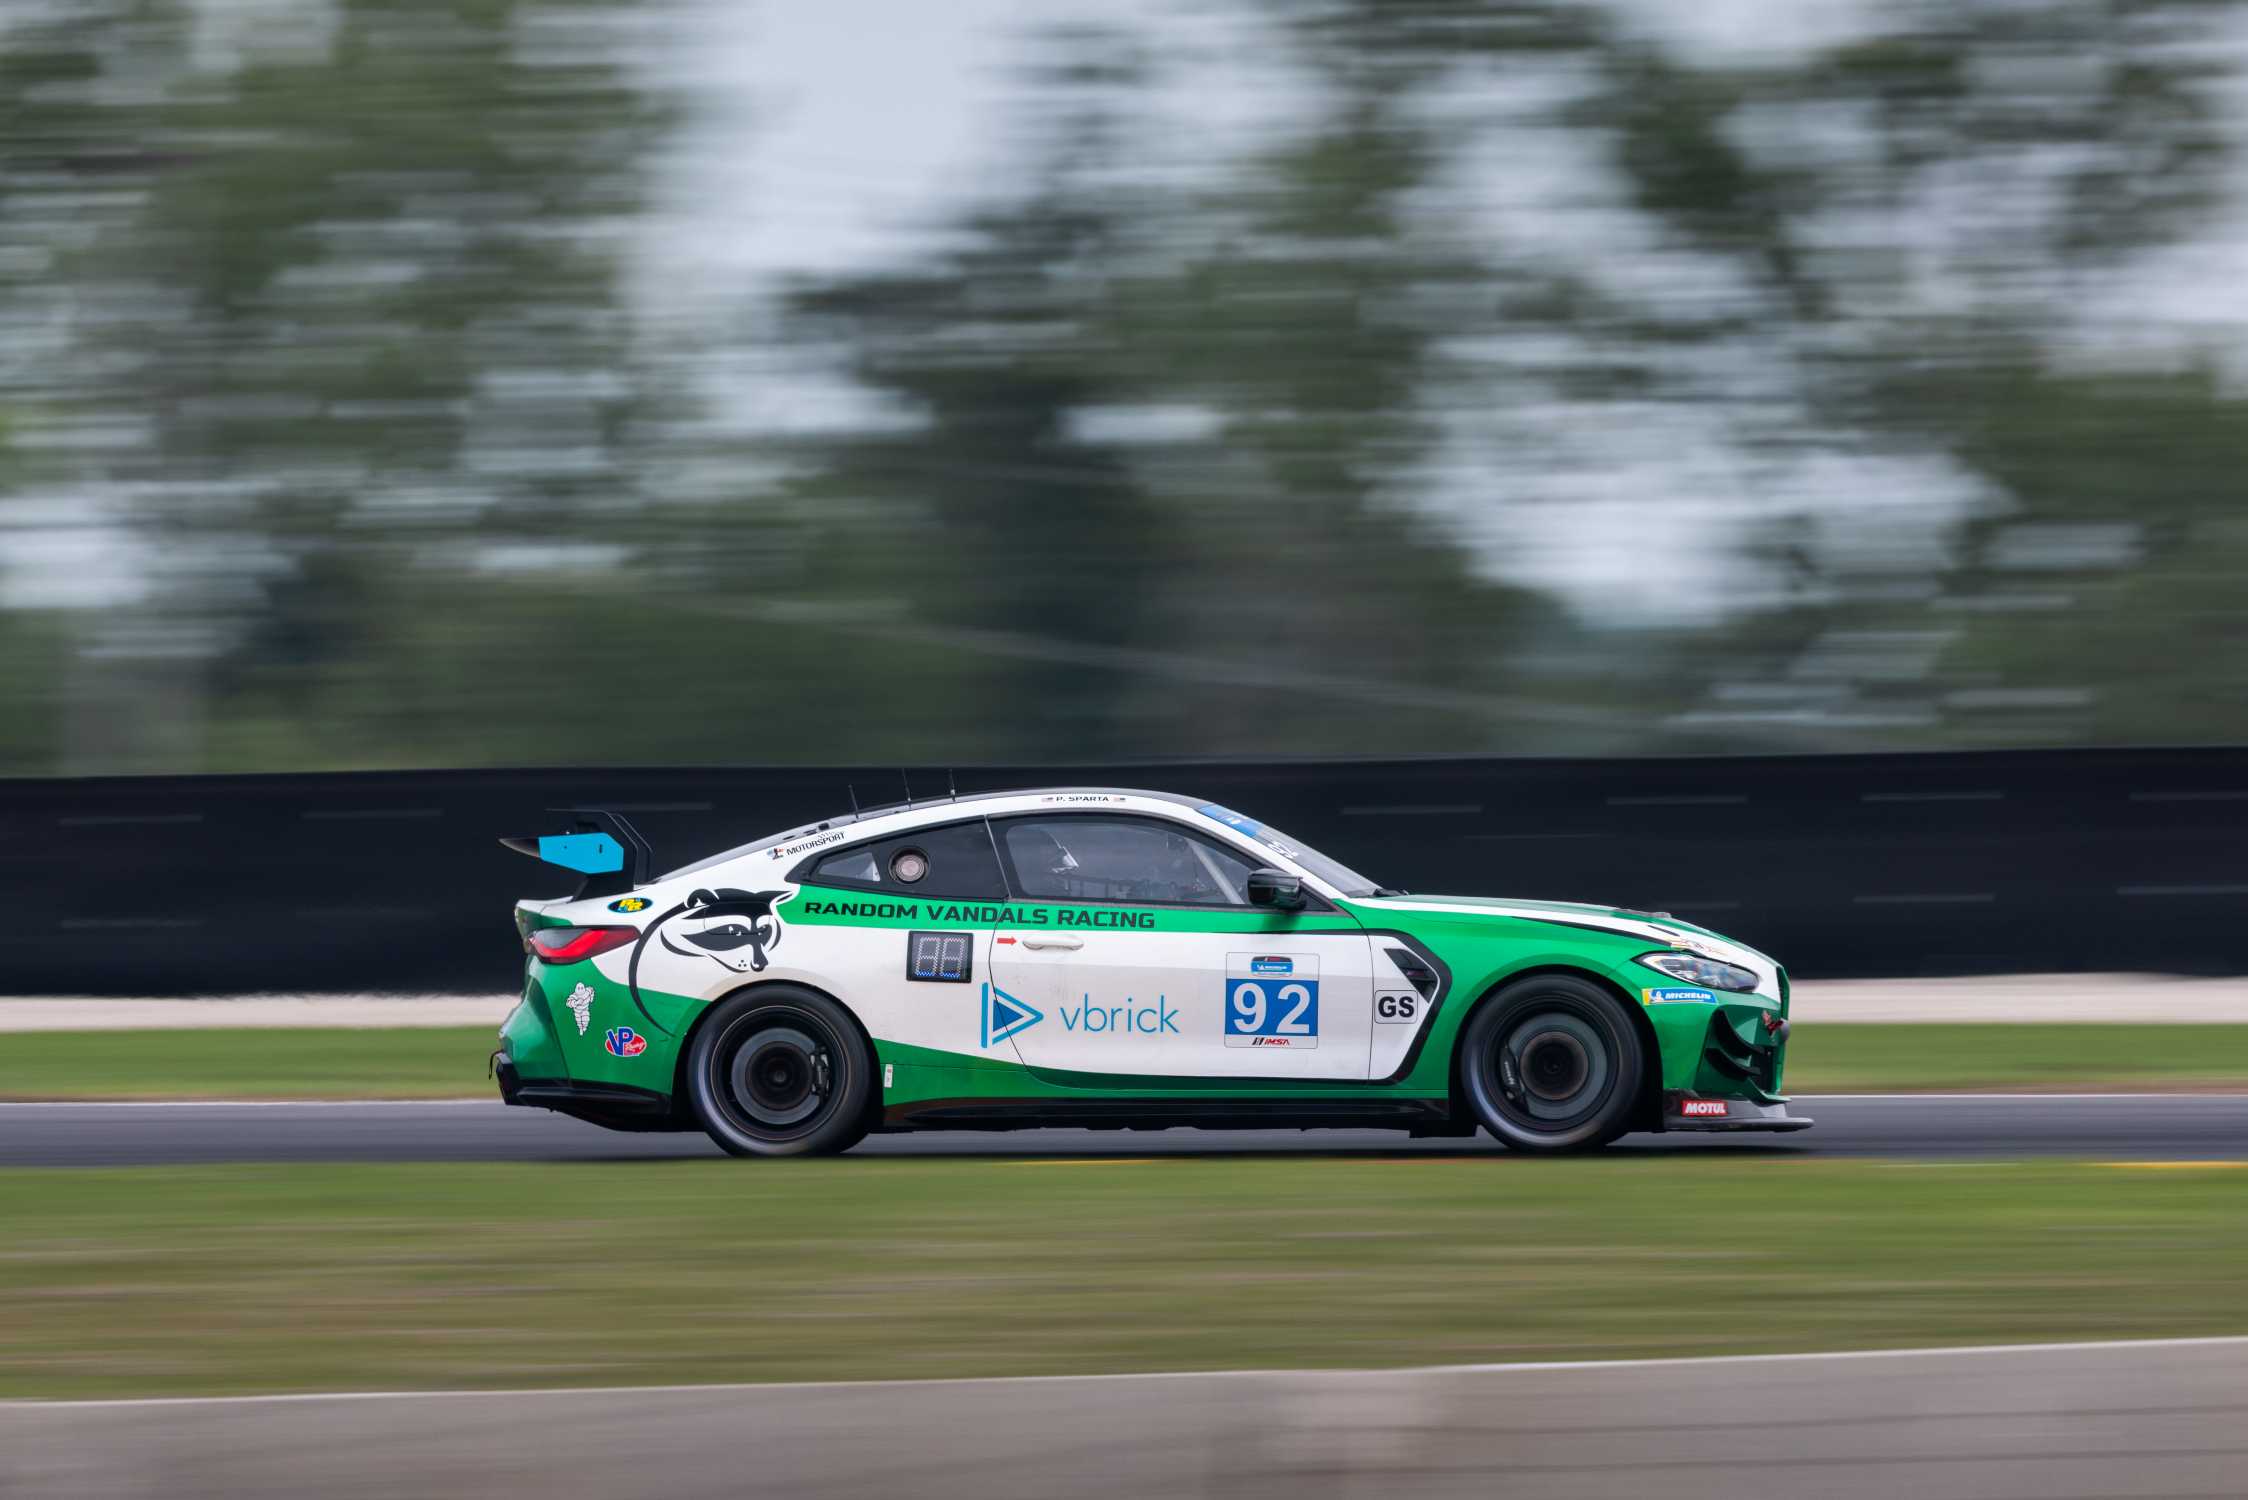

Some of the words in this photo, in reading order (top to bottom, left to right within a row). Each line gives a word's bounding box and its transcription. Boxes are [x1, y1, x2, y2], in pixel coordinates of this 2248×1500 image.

[786, 832, 845, 856] MOTORSPORT
[805, 902, 918, 920] RANDOM
[927, 905, 1048, 925] VANDALS
[1057, 909, 1155, 929] RACING
[1233, 982, 1311, 1034] 92
[1378, 996, 1415, 1018] GS
[1665, 992, 1712, 1000] MICHELIN
[1059, 992, 1180, 1033] vbrick
[606, 1027, 634, 1056] VP
[1685, 1102, 1726, 1114] MOTUL
